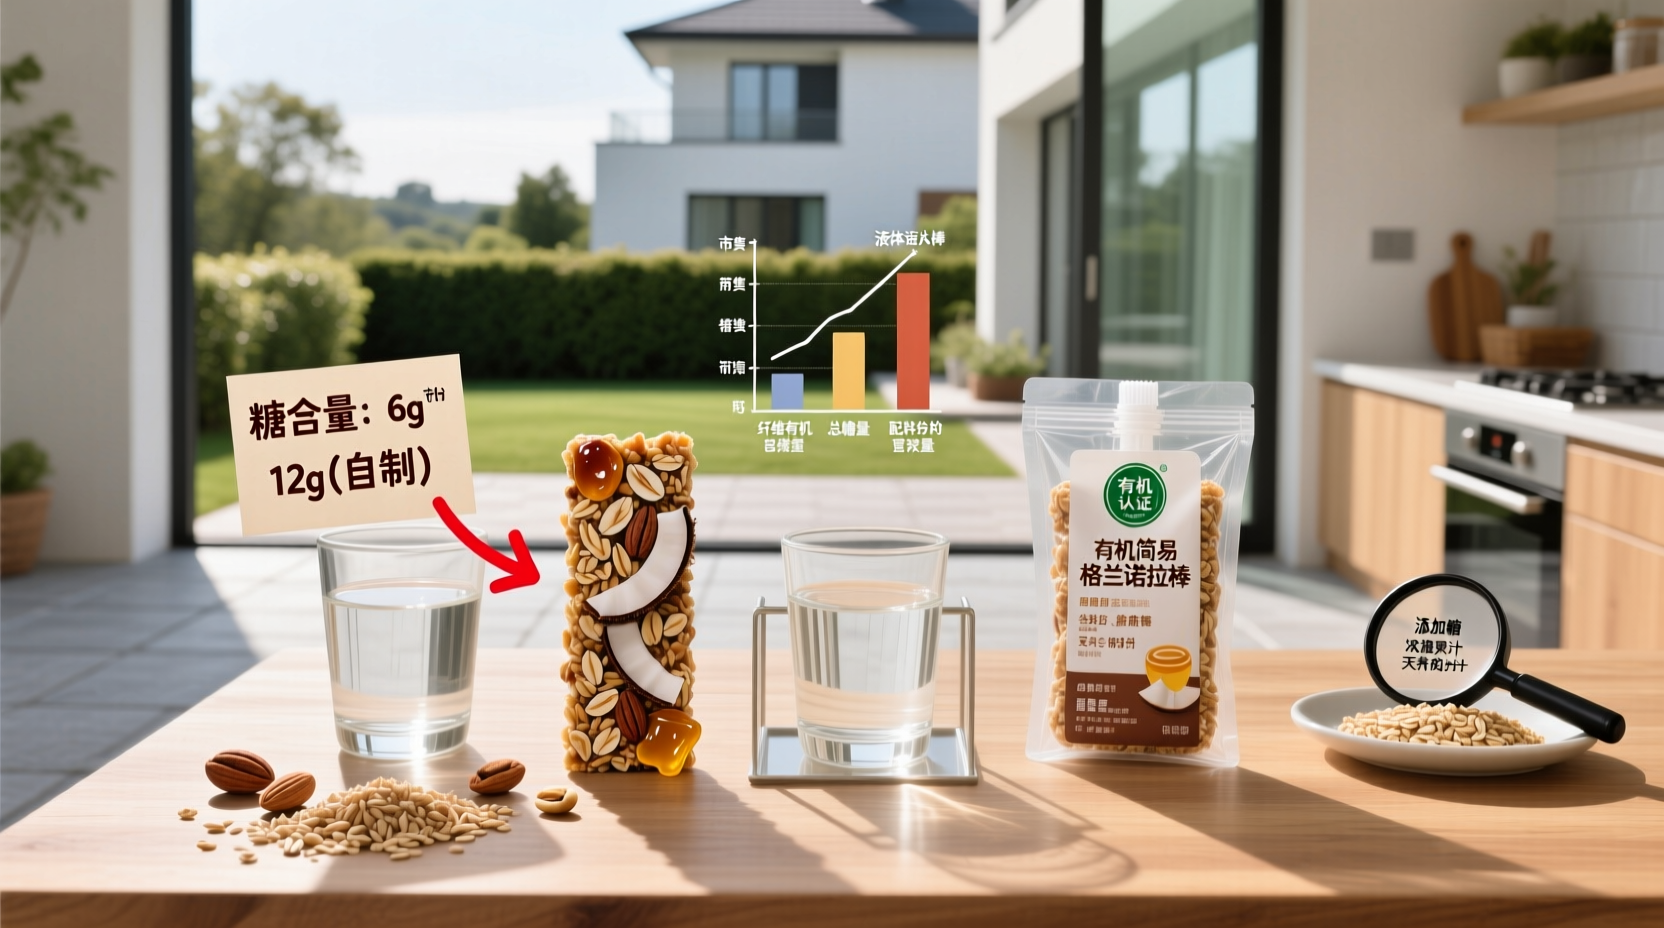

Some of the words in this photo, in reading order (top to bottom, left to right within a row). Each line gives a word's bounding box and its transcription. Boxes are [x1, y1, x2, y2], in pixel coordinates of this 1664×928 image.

[1117, 476, 1153, 495] 有机
[1117, 495, 1153, 511] 认证
[1094, 538, 1177, 561] 有机简易
[1079, 563, 1191, 588] 格兰诺拉棒
